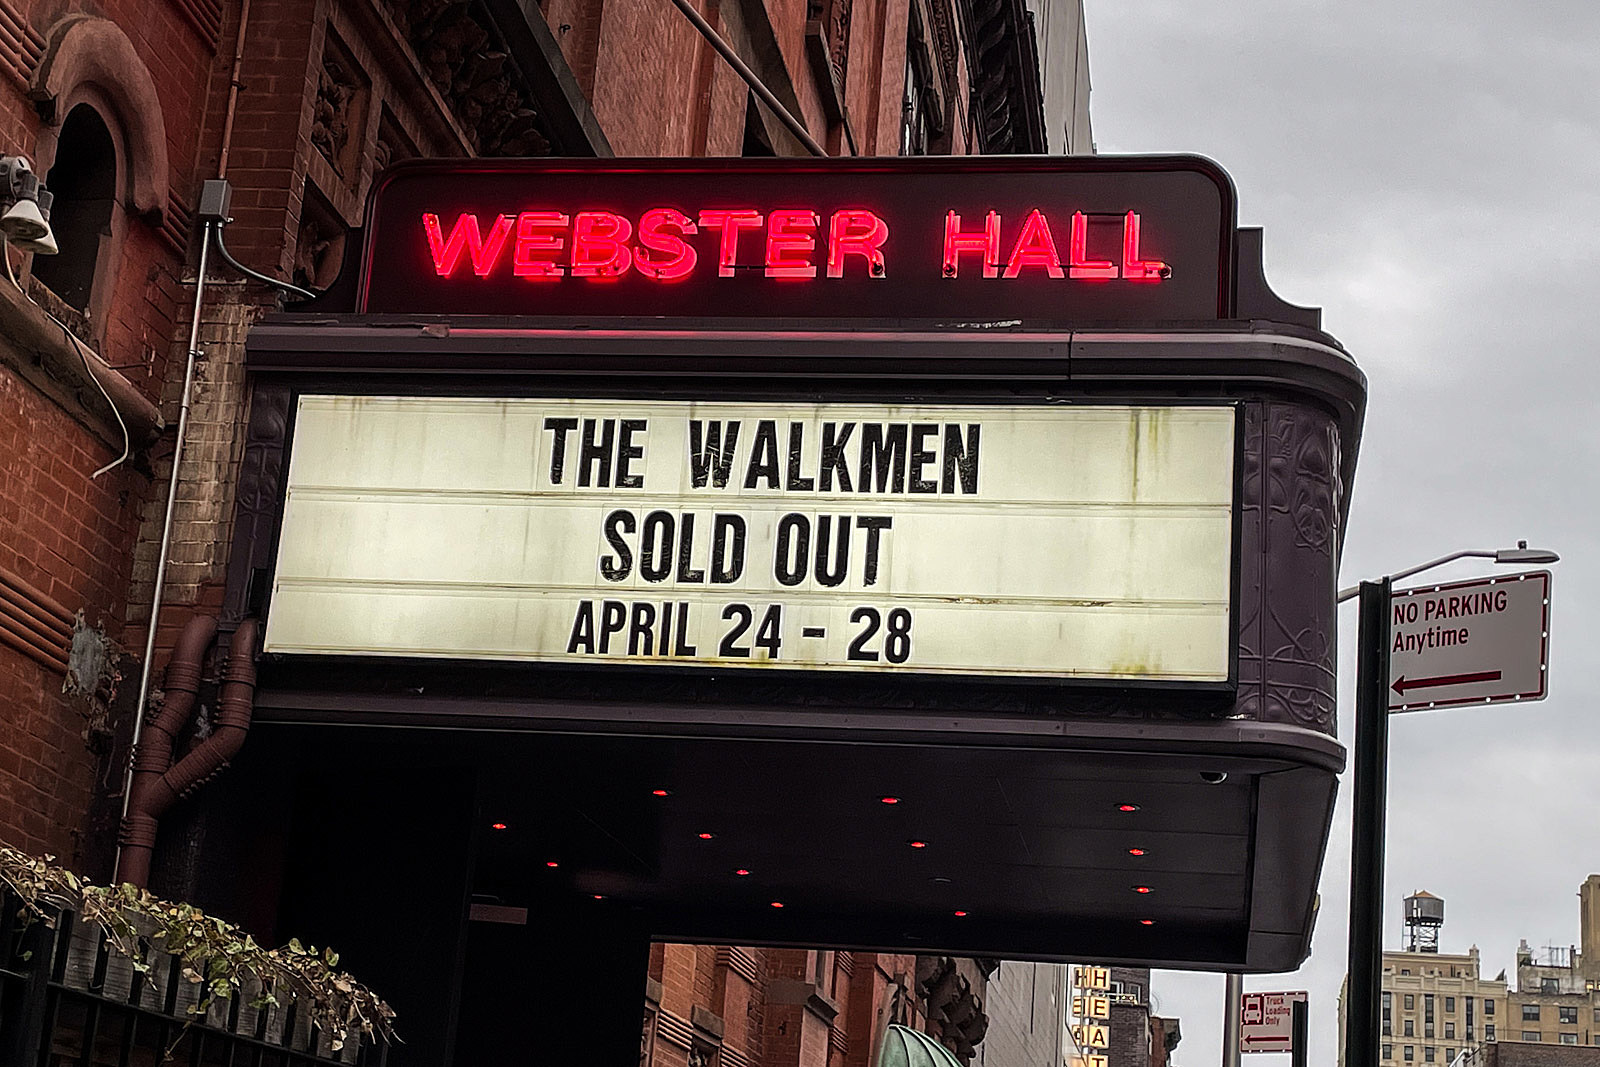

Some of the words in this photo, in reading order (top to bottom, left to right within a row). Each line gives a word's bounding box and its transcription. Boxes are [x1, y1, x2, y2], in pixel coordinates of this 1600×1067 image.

[422, 207, 888, 280] WEBSTER
[941, 208, 1172, 280] HALL
[543, 417, 648, 489] THE
[689, 419, 981, 495] WALKMEN
[600, 509, 747, 584] SOLD
[774, 512, 893, 588] OUT
[1393, 602, 1418, 626] NO
[1424, 590, 1508, 621] PARKING
[567, 600, 697, 657] APRIL
[719, 603, 782, 659] 24
[803, 627, 825, 639] -
[847, 607, 912, 664] 28
[1392, 626, 1469, 655] Anytime
[1265, 1006, 1290, 1016] Loading
[1266, 996, 1284, 1005] Truck
[1265, 1016, 1280, 1026] Only
